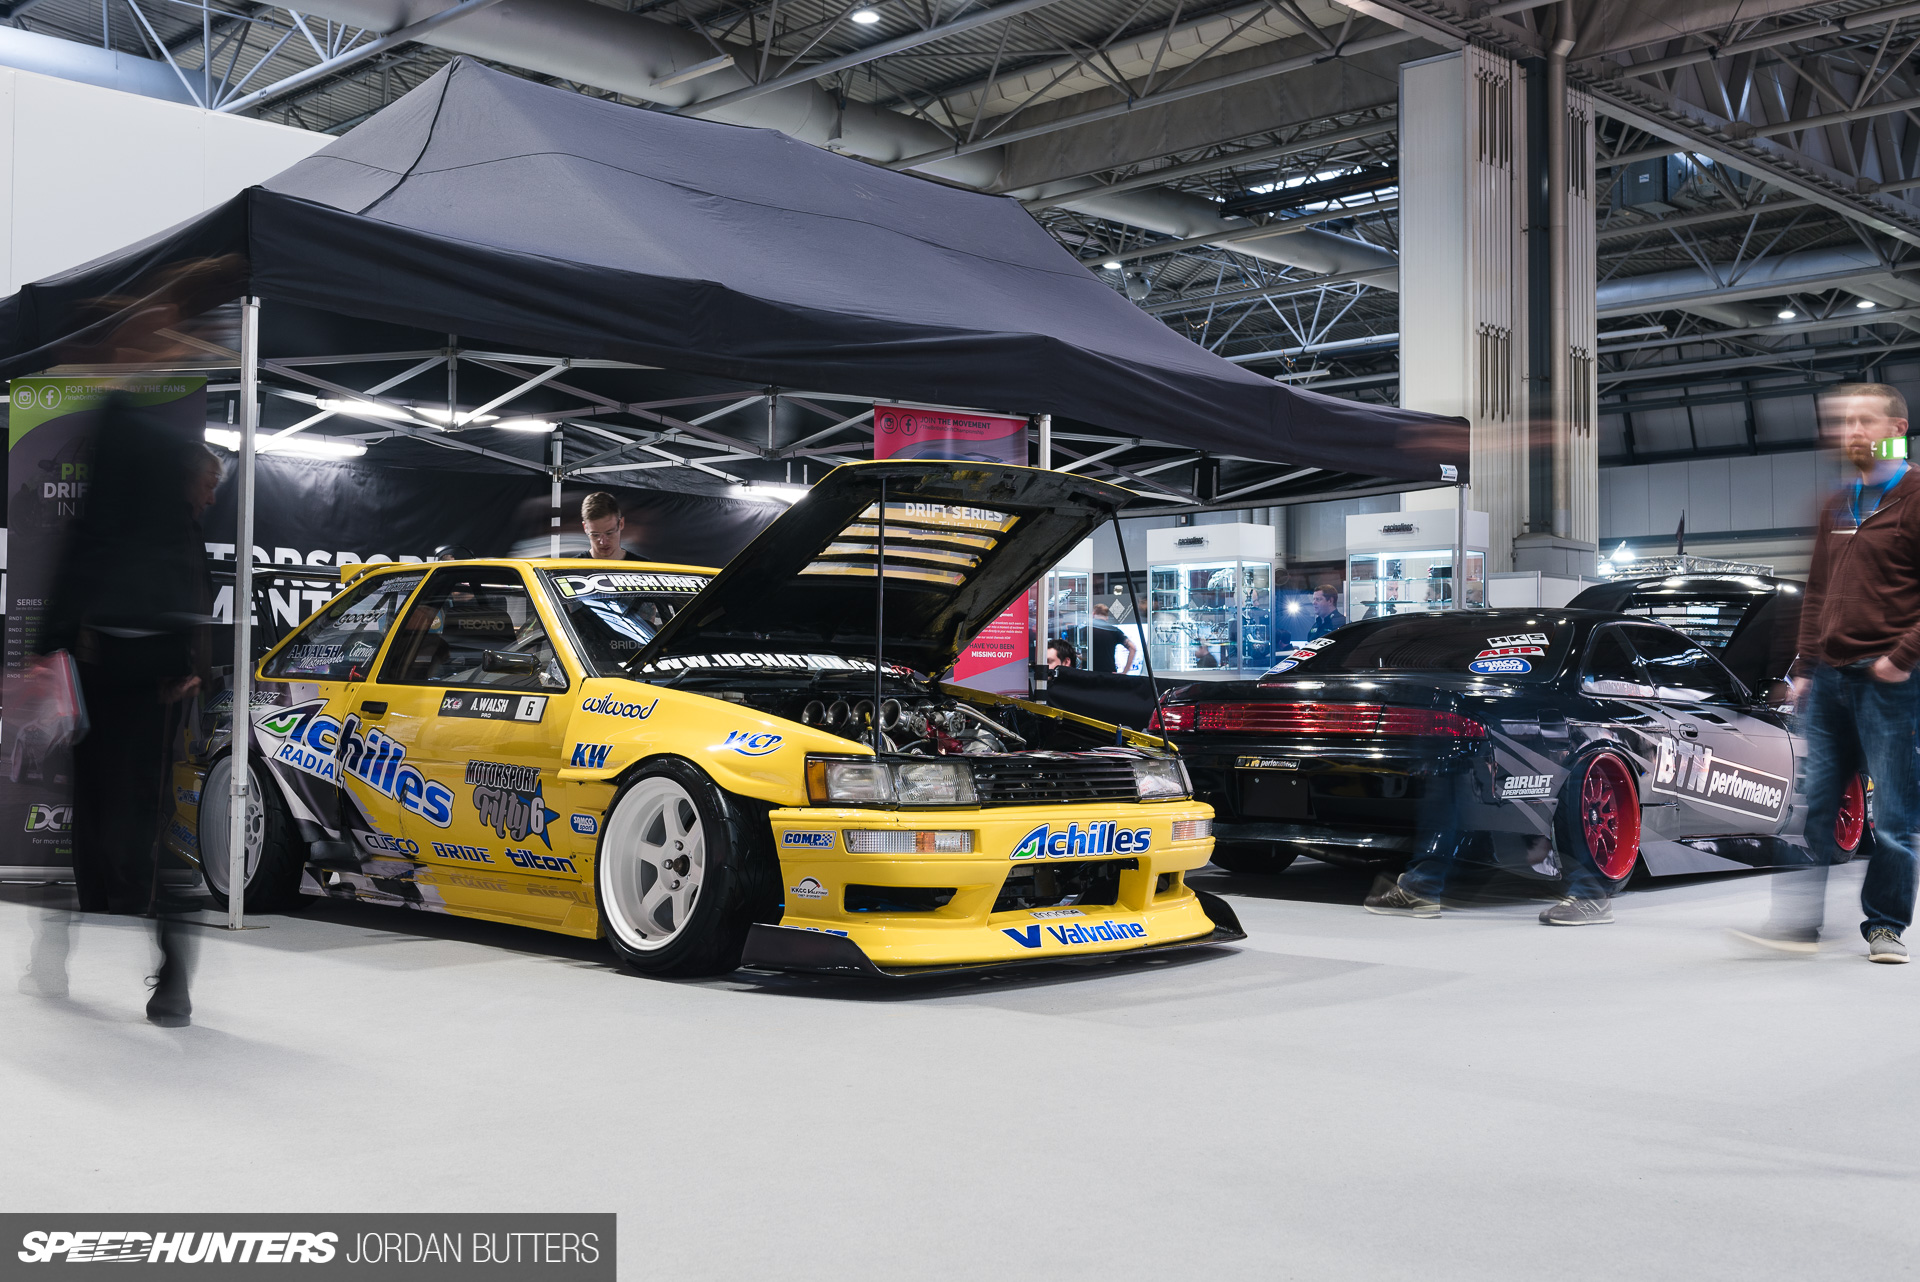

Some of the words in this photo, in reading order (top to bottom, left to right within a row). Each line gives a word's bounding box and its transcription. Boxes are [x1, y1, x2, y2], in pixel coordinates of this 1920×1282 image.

[65, 385, 84, 394] FOR
[142, 384, 161, 393] THE
[163, 384, 187, 393] FANS
[919, 415, 936, 425] JOIN
[937, 417, 952, 426] THE
[952, 418, 992, 430] MOVEMENT
[61, 463, 89, 481] PR
[43, 482, 89, 499] DRIF
[905, 502, 946, 519] DRIFT
[951, 505, 1003, 522] SERIES
[607, 574, 661, 587] IRISH
[655, 575, 707, 589] DRIFT
[16, 598, 43, 606] SERIES
[457, 618, 506, 632] RECARO
[1488, 633, 1547, 646] HKS
[971, 650, 997, 659] MISSING
[997, 651, 1013, 659] OUT?
[1477, 646, 1542, 658] ARP
[524, 700, 536, 717] 6
[582, 691, 660, 721] wilwood
[254, 697, 456, 829] Achilles
[569, 741, 615, 769] KW
[276, 743, 344, 788] RADIAL
[1656, 736, 1713, 794] BTN
[465, 759, 541, 793] MOTORSPORT
[1707, 769, 1782, 810] performance
[32, 837, 43, 845] For
[60, 837, 73, 845] info
[365, 834, 420, 856] CUSCO
[784, 832, 823, 845] COMP
[1009, 820, 1153, 860] Achilles
[434, 841, 496, 864] BRIDE
[504, 846, 578, 874] tilton
[1045, 920, 1148, 945] Valvoline
